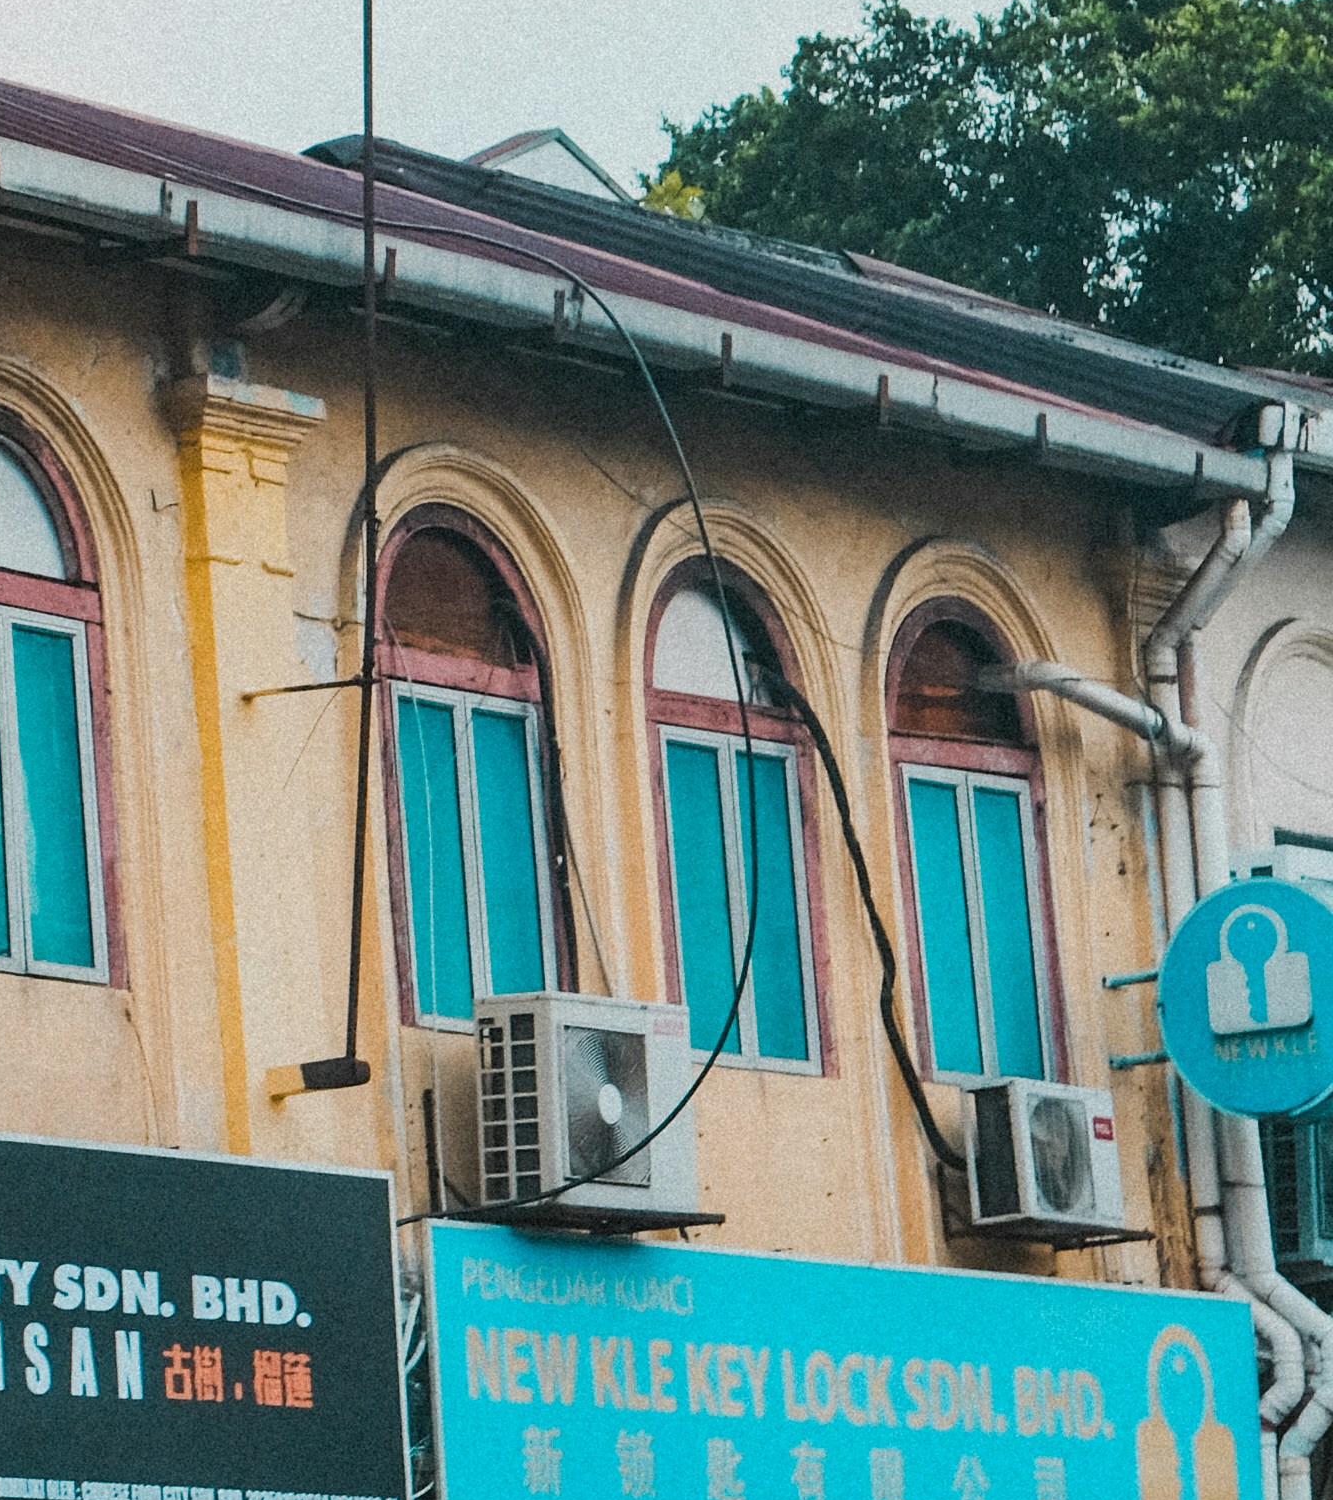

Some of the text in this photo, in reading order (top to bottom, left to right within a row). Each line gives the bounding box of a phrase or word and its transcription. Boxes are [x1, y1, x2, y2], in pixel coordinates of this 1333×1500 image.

[54, 1264, 175, 1318] SDN.
[192, 1275, 312, 1328] BHD.
[462, 1257, 694, 1316] PENGEDAR KUNCI
[466, 1326, 1116, 1439] NEW KLE KEY LOCK SDN. BHD.
